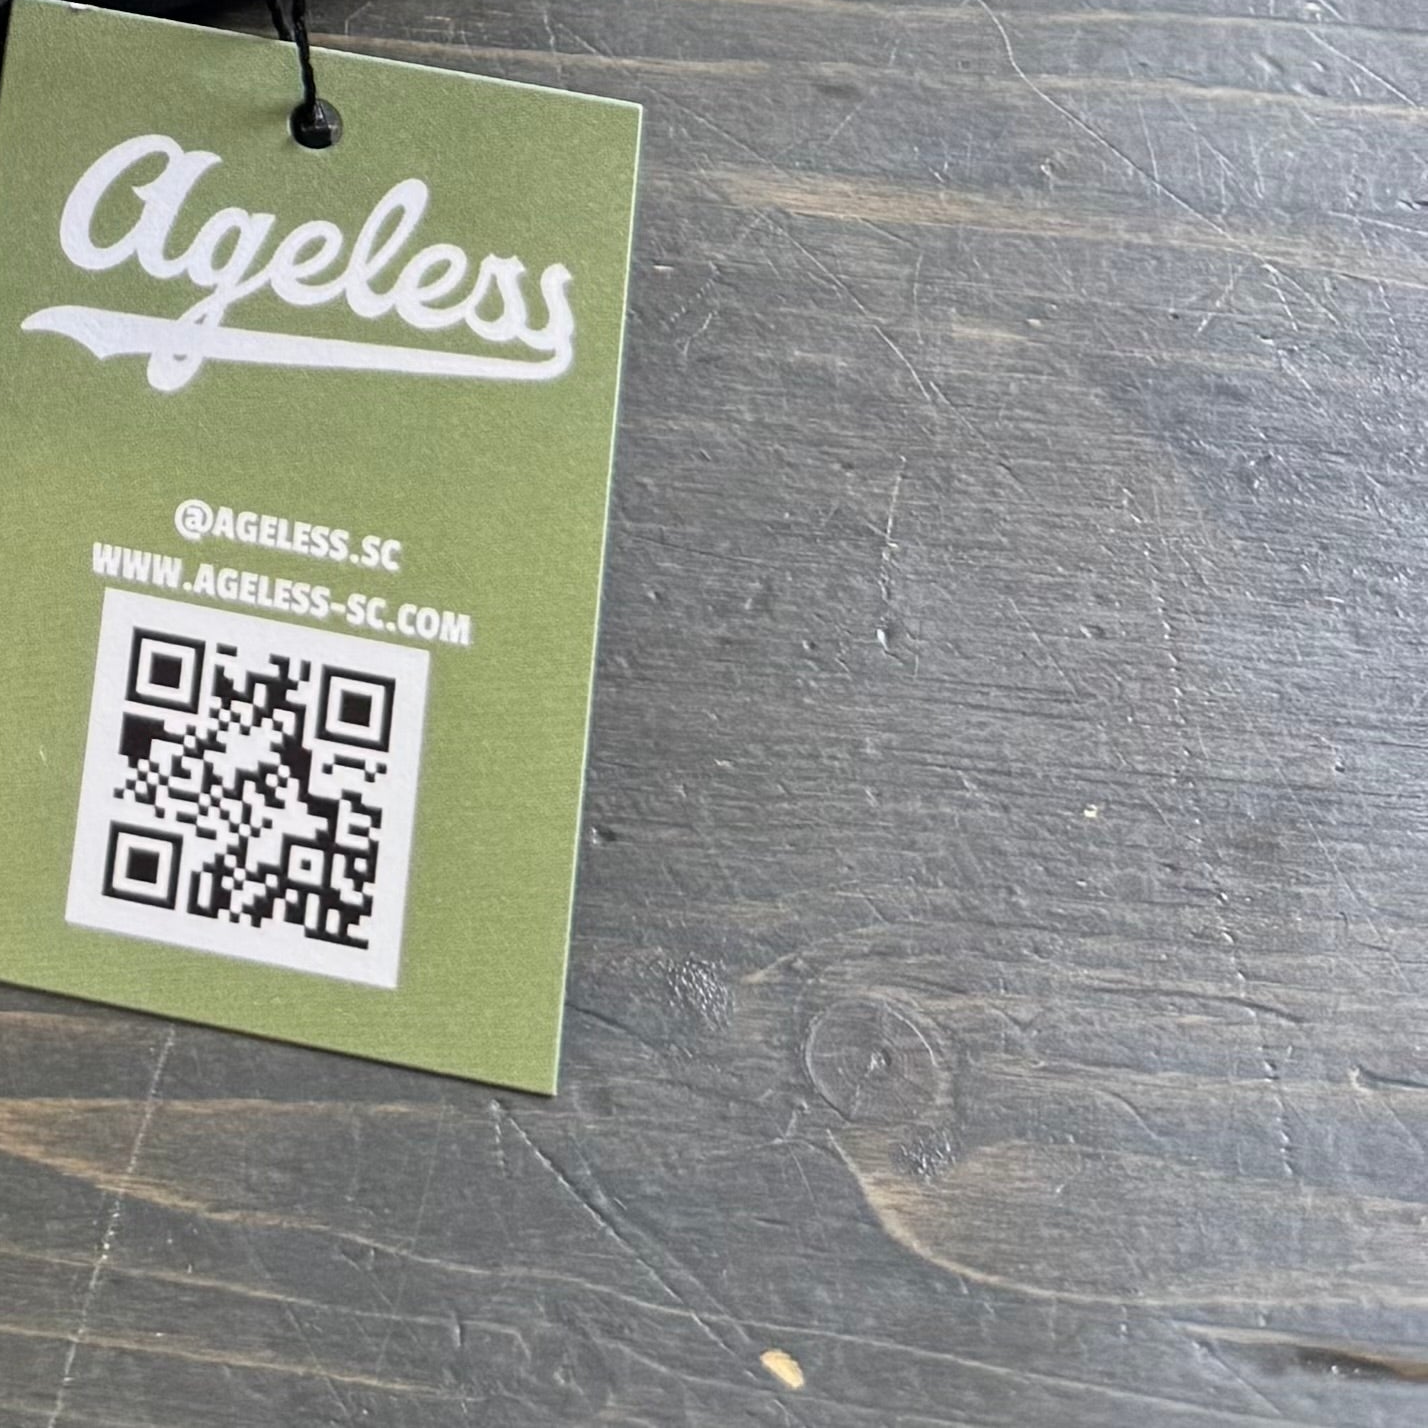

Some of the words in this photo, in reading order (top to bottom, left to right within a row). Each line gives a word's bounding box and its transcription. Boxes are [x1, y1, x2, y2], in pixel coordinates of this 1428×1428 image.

[21, 134, 574, 391] Ageless
[174, 499, 403, 572] @AGELESS.SC
[92, 542, 473, 645] WWW.AGELESS-SC.COM
